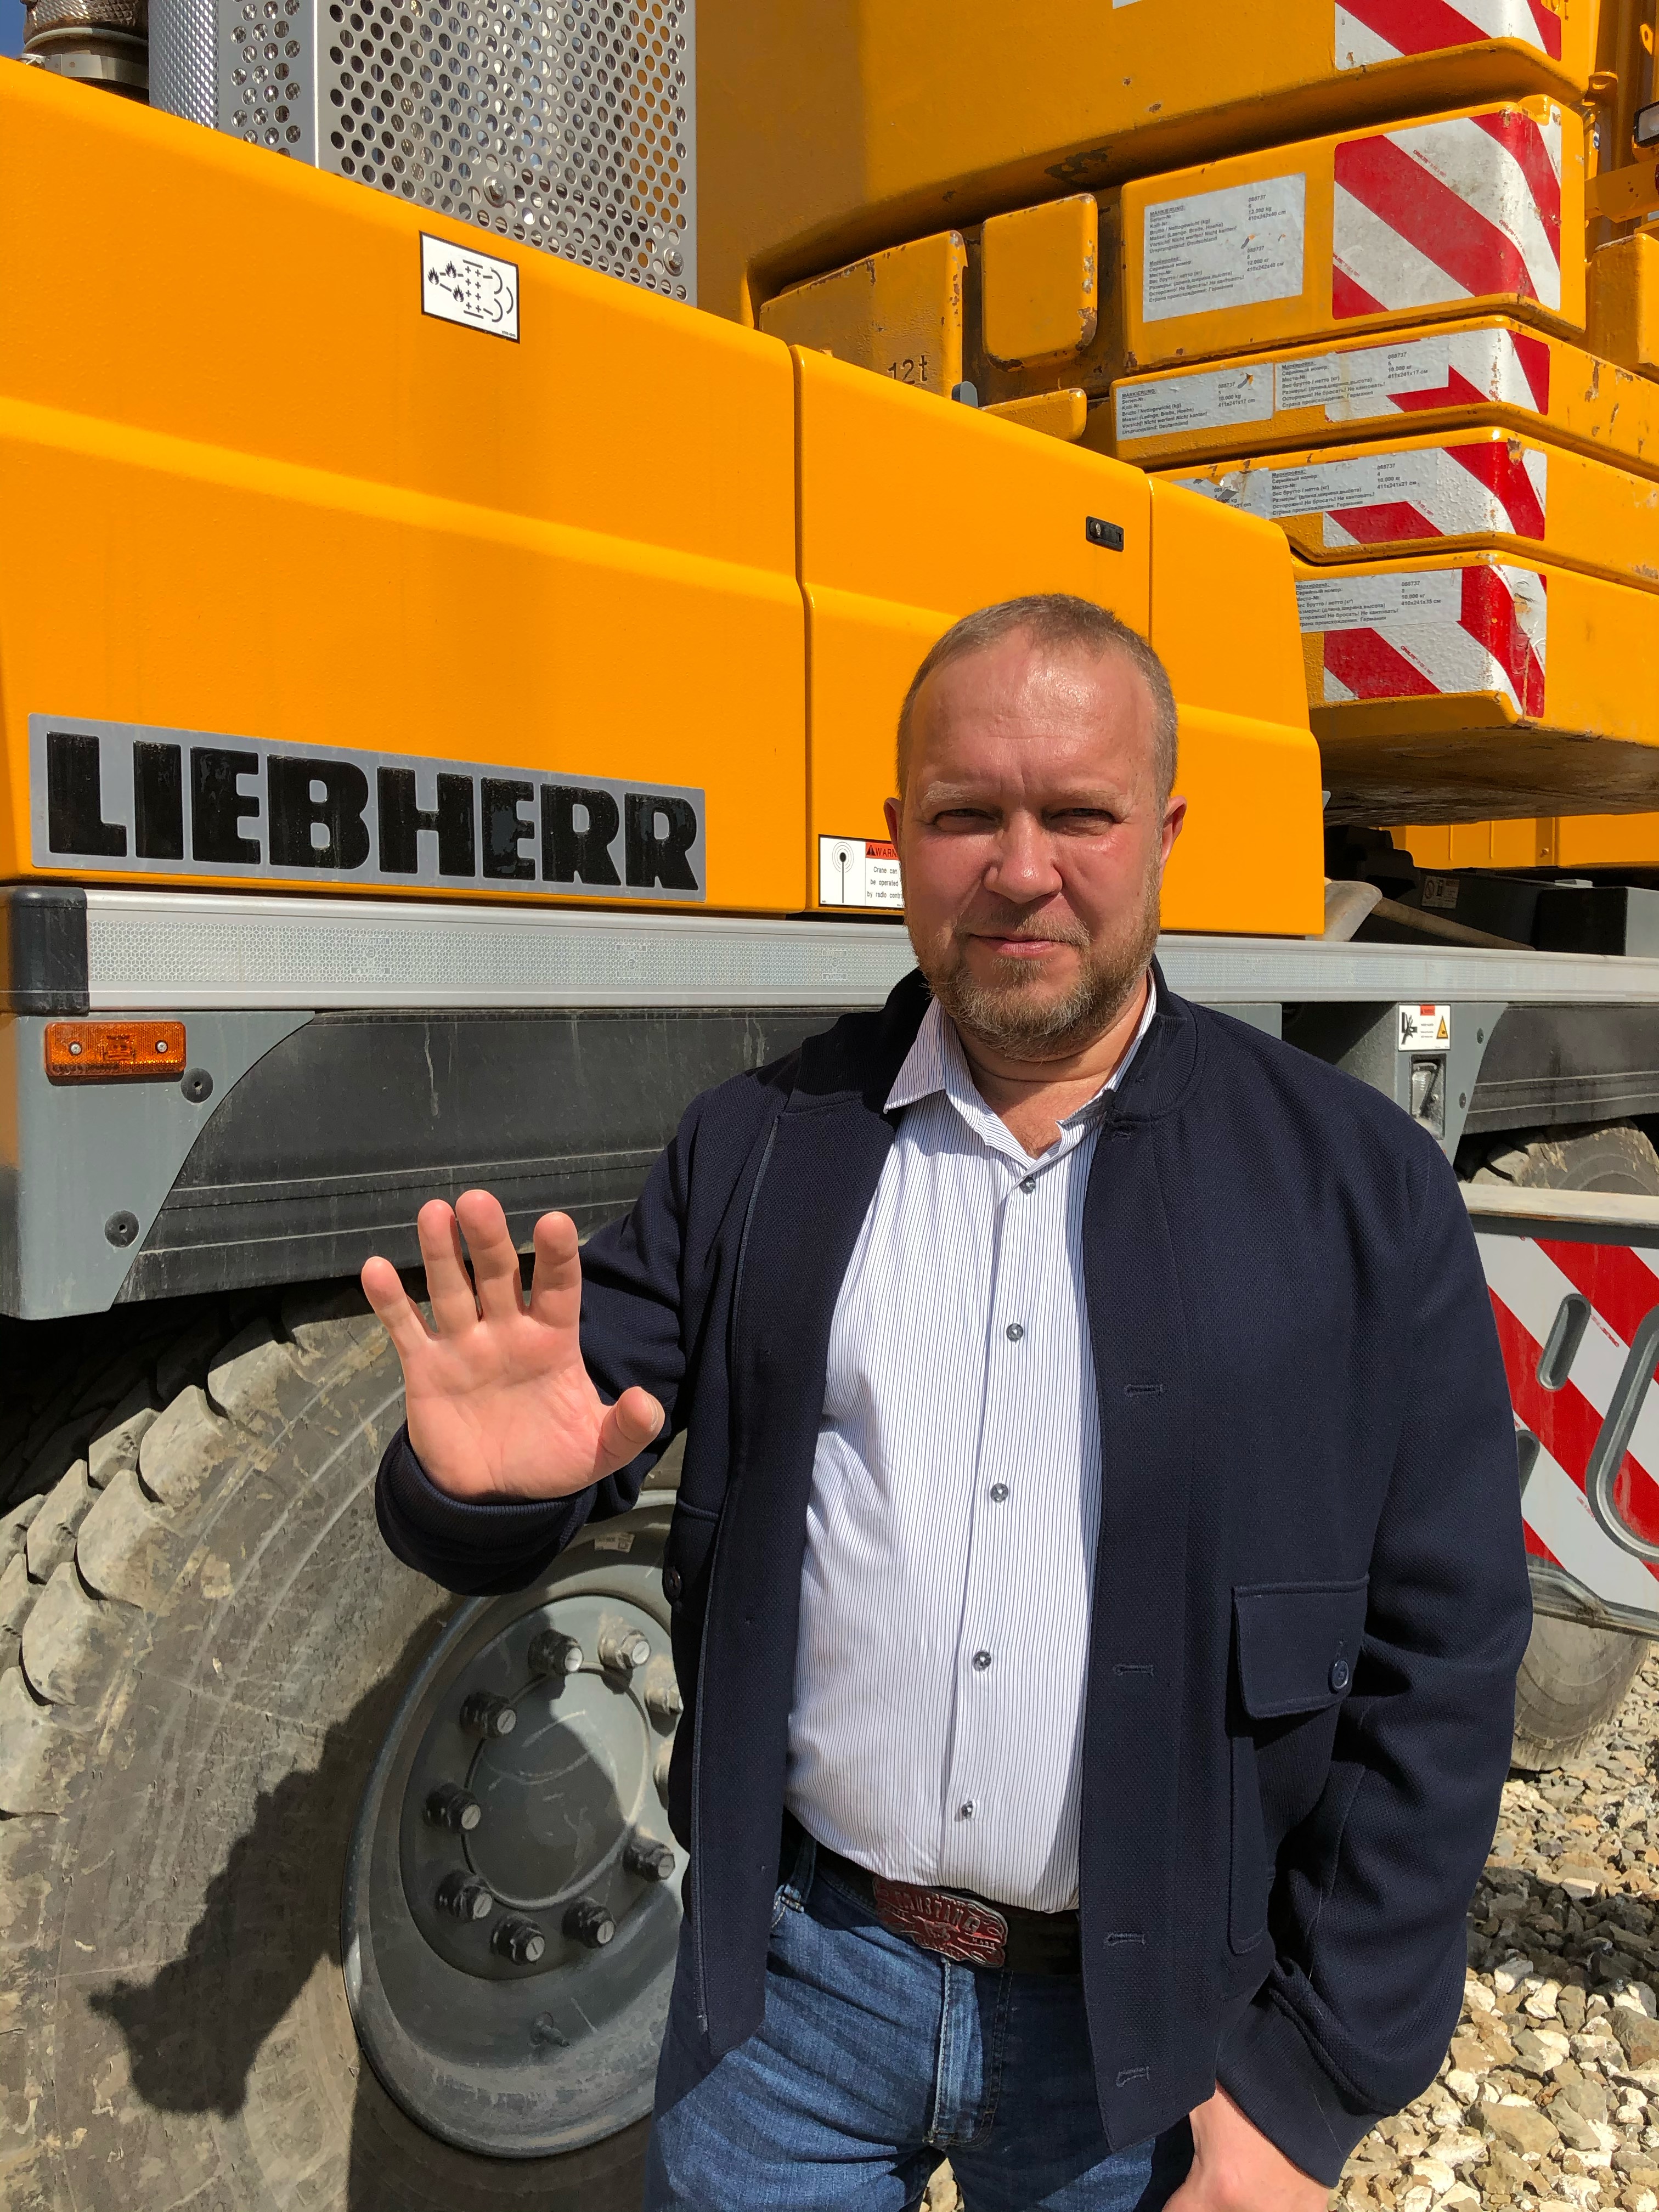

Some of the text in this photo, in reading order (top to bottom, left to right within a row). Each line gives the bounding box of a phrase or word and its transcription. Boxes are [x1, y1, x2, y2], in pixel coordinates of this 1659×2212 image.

[1388, 370, 1419, 379] 411x241x17
[1347, 390, 1373, 398] Германия
[1140, 405, 1170, 414] Nettogewicht
[1159, 421, 1188, 429] Deutschland
[1346, 492, 1374, 500] кантовать!
[47, 731, 699, 891] LIEBHERR
